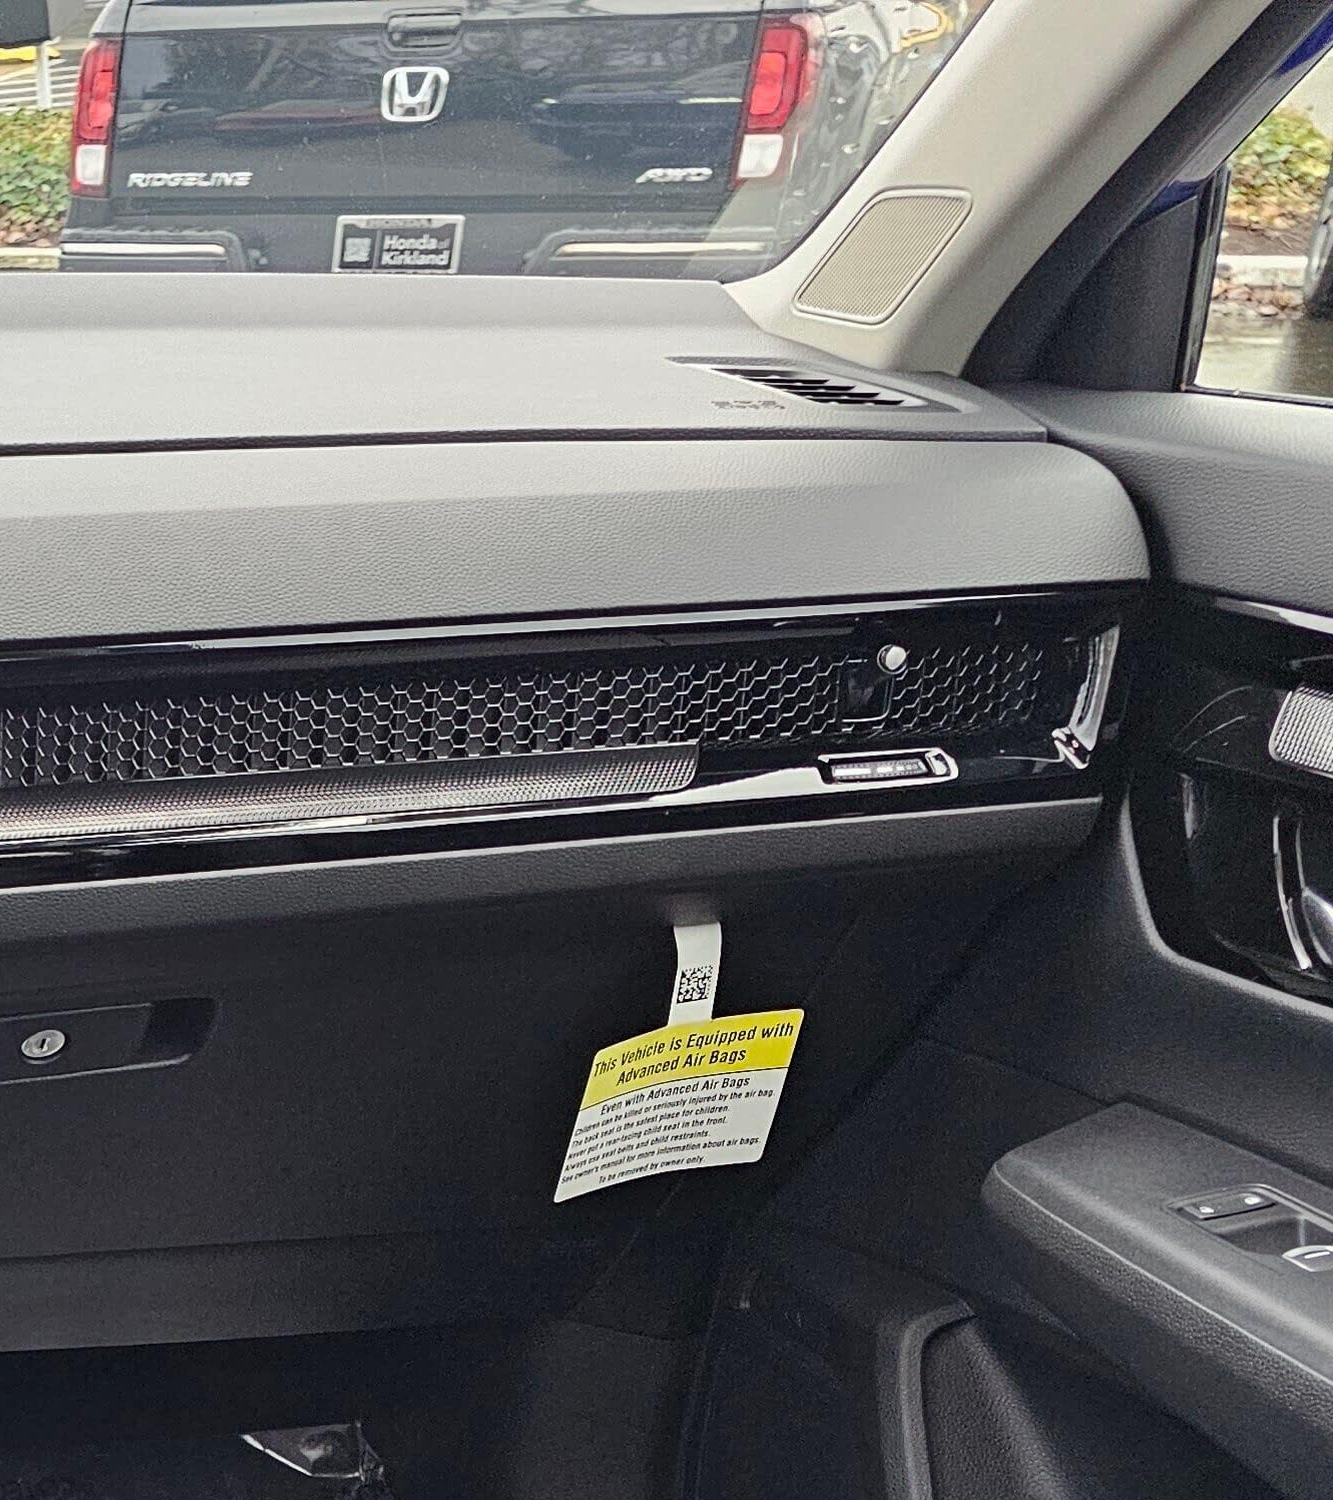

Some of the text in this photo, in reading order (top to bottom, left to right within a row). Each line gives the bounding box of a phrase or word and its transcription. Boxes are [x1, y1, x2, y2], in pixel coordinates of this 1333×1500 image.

[128, 170, 252, 188] RIDGELINE
[635, 165, 713, 185] AWD
[381, 250, 450, 266] Kirkland
[384, 233, 438, 250] Honda
[593, 1022, 794, 1078] This Vehicle is Equipped with
[616, 1048, 747, 1087] Advanced Air Bags
[574, 1122, 600, 1136] Children
[601, 1117, 613, 1127] can
[624, 1108, 643, 1119] killed
[653, 1098, 687, 1111] seriously
[689, 1093, 717, 1105] injured
[730, 1091, 743, 1099] the
[744, 1090, 757, 1098] air
[758, 1089, 775, 1099] bag.
[600, 1077, 751, 1116] Even with Advanced Air Bags
[572, 1140, 583, 1148] The
[584, 1132, 599, 1144] back
[600, 1129, 614, 1139] seat
[623, 1122, 635, 1130] the
[635, 1114, 658, 1124] safest
[659, 1111, 680, 1122] place
[681, 1110, 693, 1118] for
[695, 1105, 730, 1115] children.
[561, 1136, 761, 1184] See owner's manual for more information about air bags.
